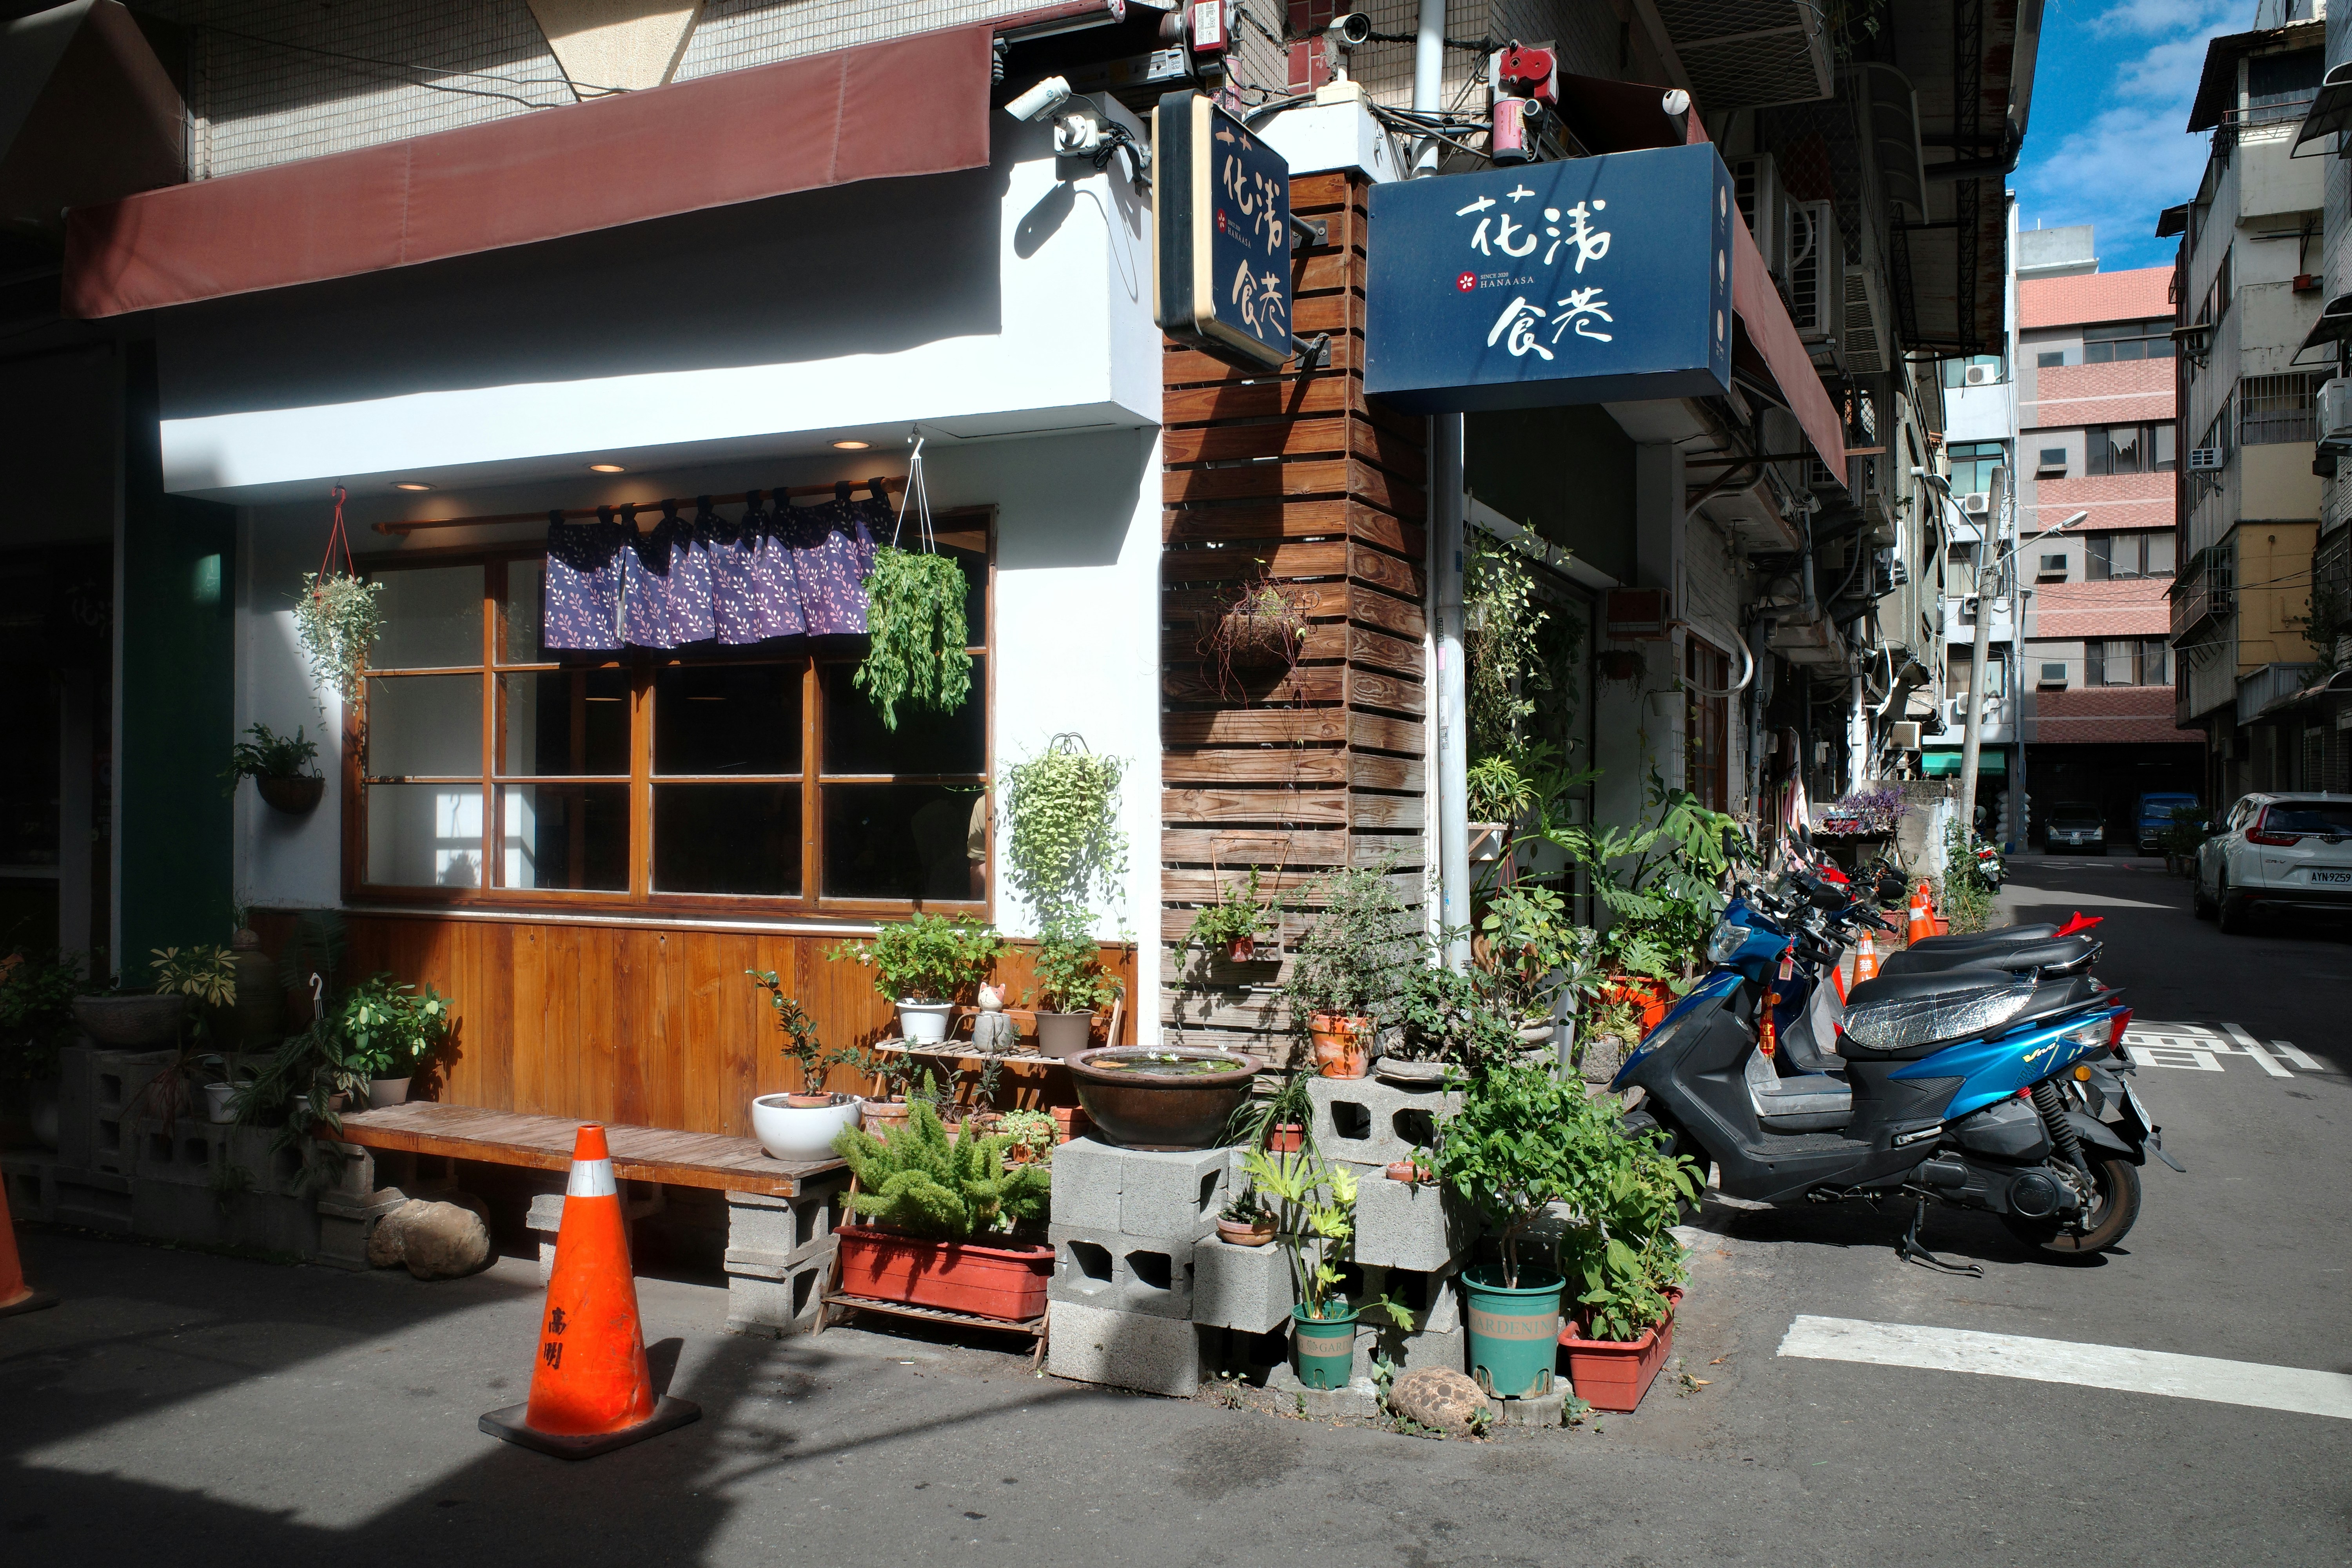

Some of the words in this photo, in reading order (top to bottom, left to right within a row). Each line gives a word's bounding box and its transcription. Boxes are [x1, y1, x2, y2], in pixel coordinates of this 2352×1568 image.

[1228, 227, 1251, 249] HANAASA
[1480, 276, 1534, 289] HANAASA
[2311, 872, 2351, 882] AYN-9259
